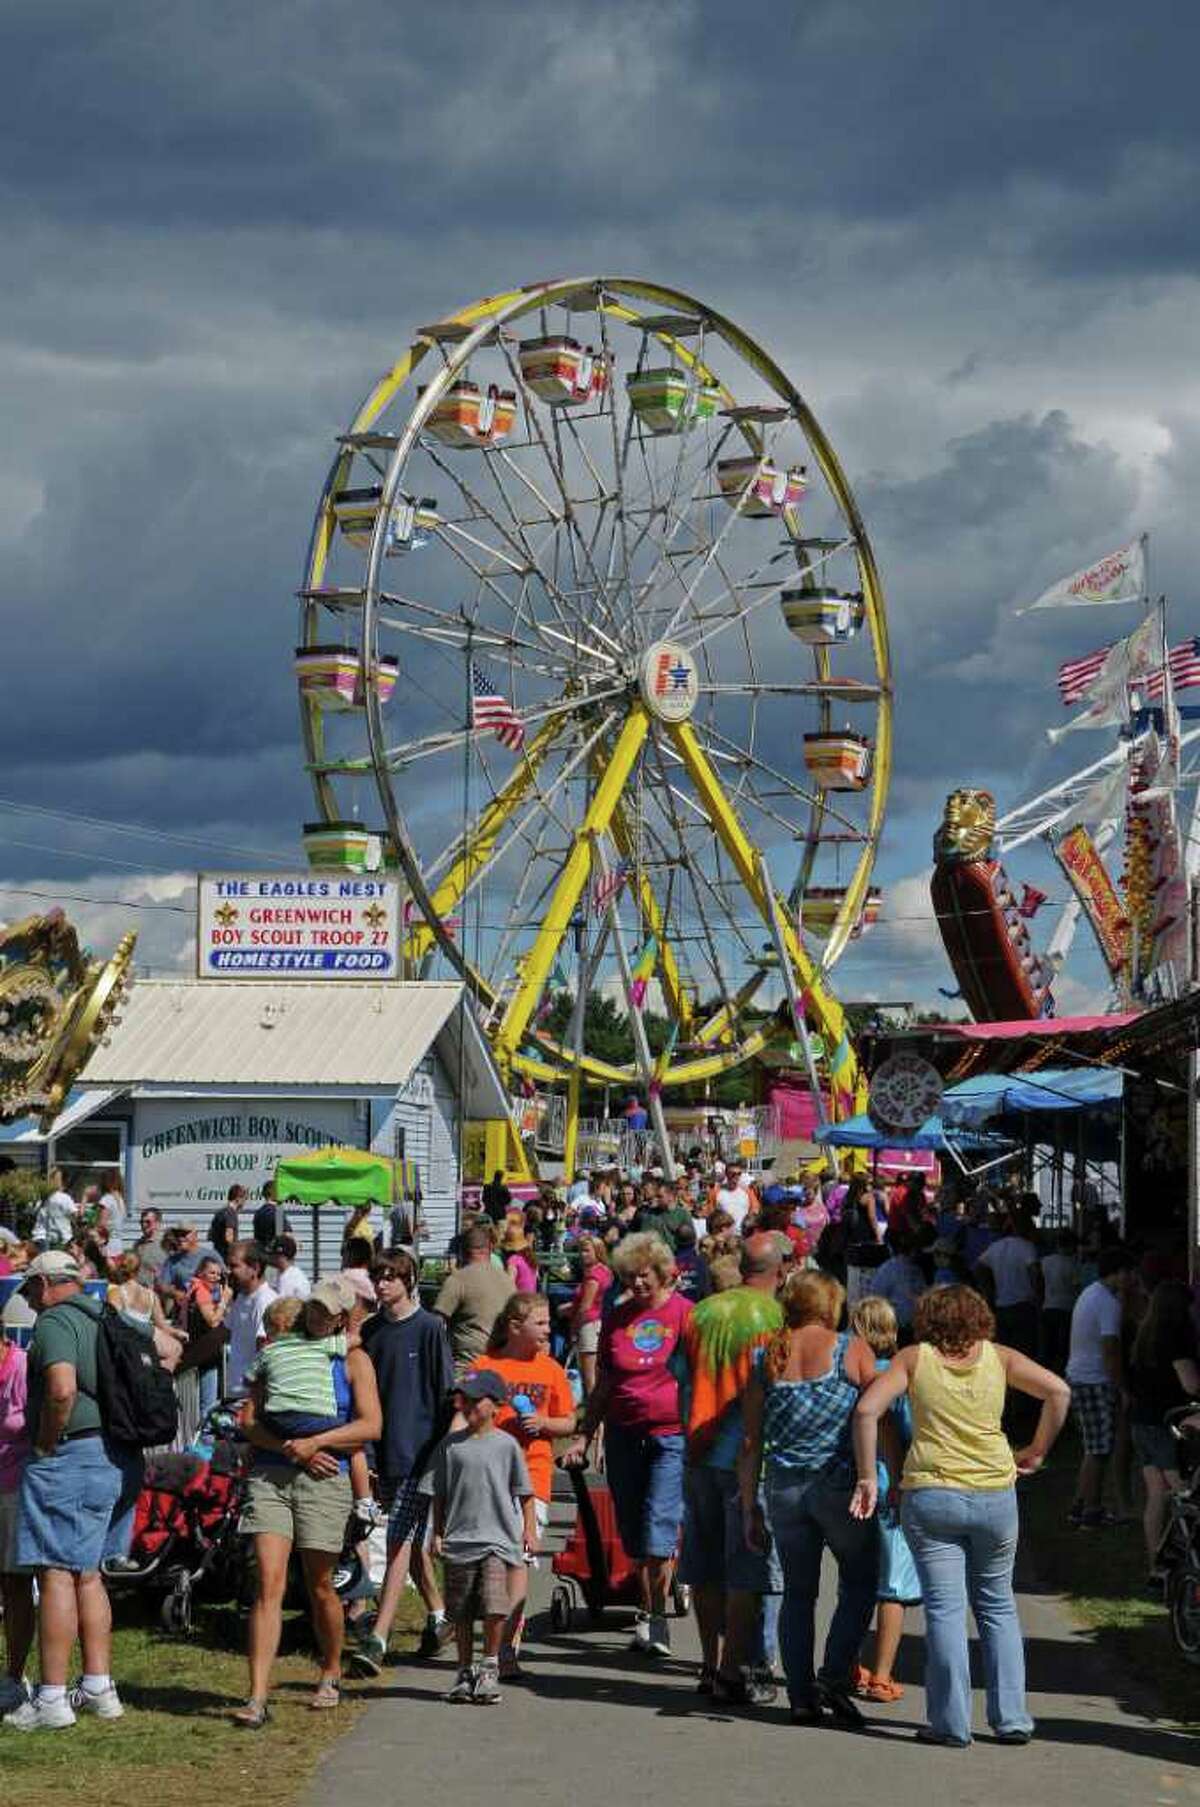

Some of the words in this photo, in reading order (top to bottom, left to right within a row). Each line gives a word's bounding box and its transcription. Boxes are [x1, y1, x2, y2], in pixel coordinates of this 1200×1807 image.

[216, 881, 250, 896] THE
[259, 881, 329, 896] EAGLES
[339, 881, 387, 896] NEST
[249, 908, 352, 924] GREENWICH
[211, 929, 242, 945] BOY
[251, 929, 303, 945] SCOUT
[310, 929, 365, 945] TROOP
[372, 931, 389, 946] 27
[217, 953, 325, 968] HOMESTYLE
[334, 953, 384, 968] FOOD
[142, 1116, 241, 1159] GREENWICH
[249, 1116, 283, 1140] BOY
[205, 1153, 260, 1171] TROOP
